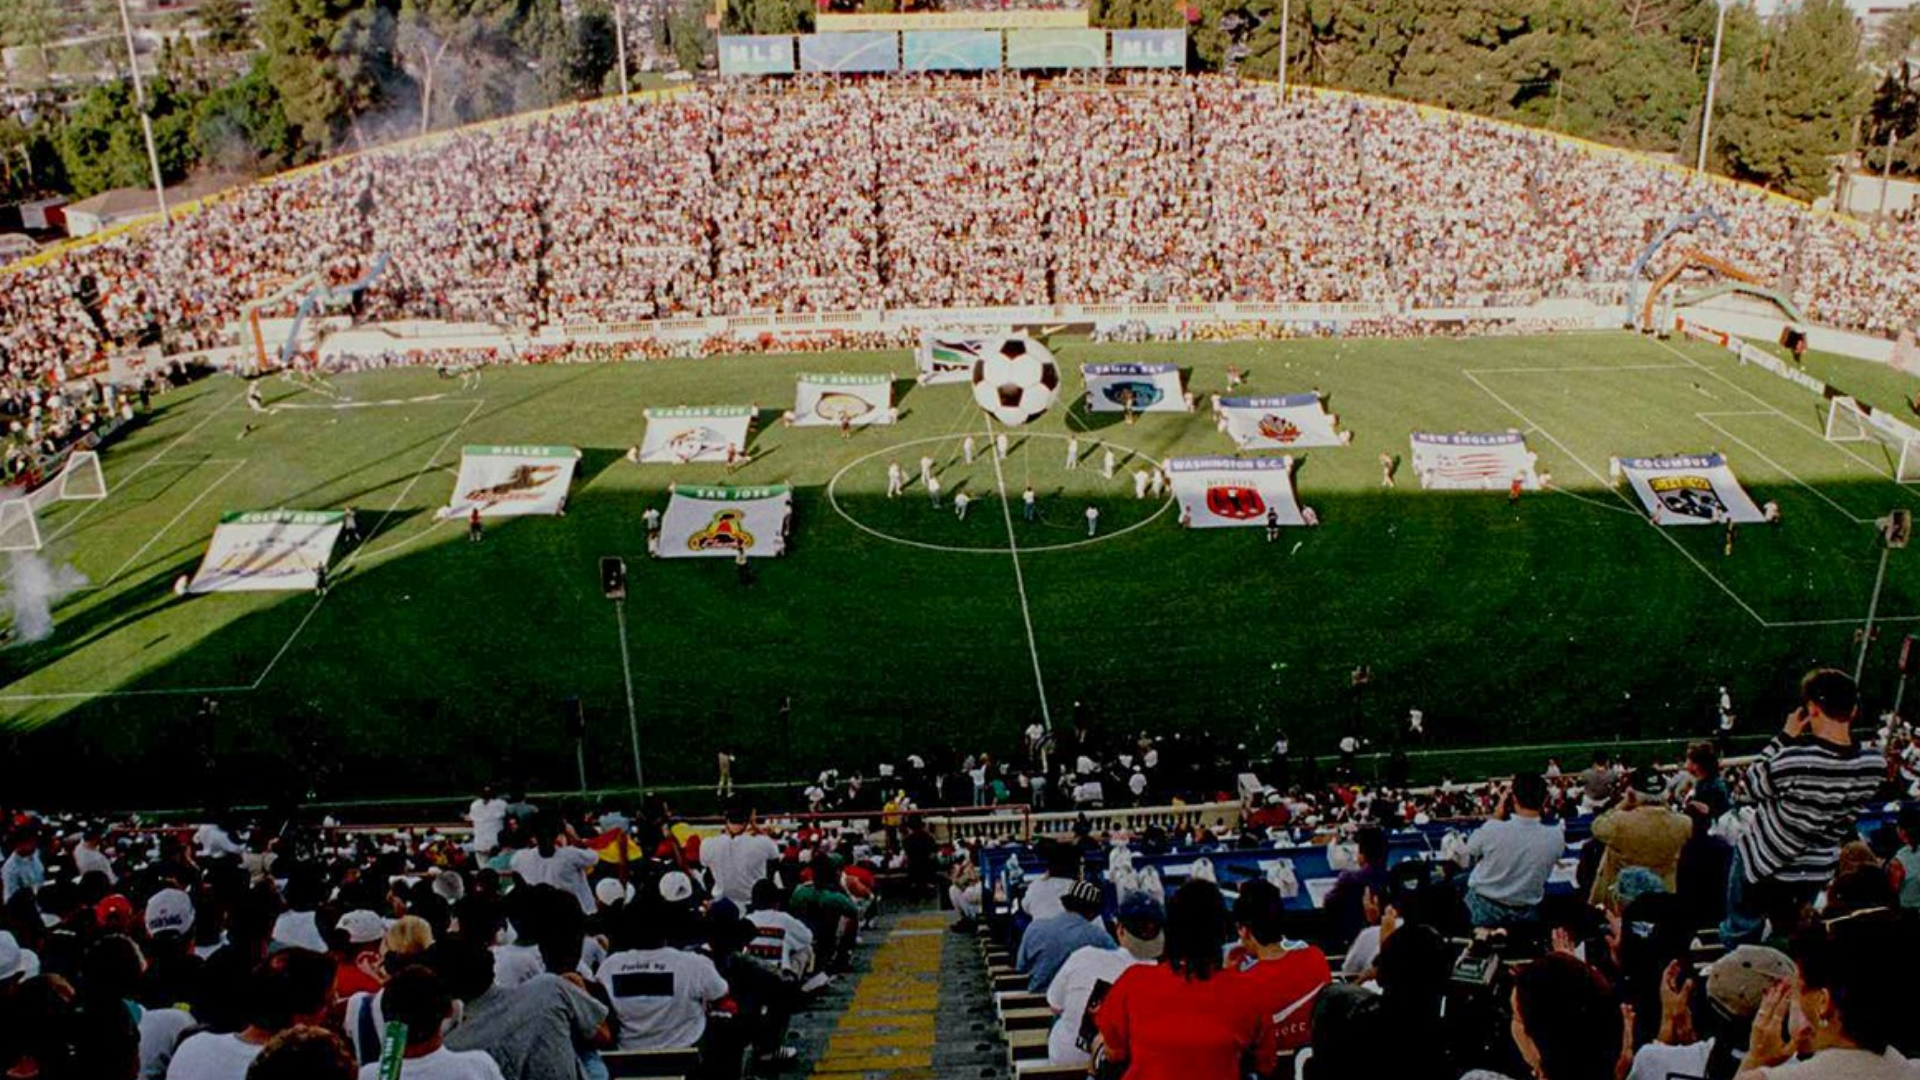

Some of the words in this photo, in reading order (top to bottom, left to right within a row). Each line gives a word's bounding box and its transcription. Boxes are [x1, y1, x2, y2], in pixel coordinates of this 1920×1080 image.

[730, 44, 784, 62] MLS
[1122, 39, 1176, 57] MLS
[1095, 364, 1137, 373] TAMPA
[1141, 364, 1164, 373] BAY
[656, 407, 710, 417] KANSAS
[714, 406, 745, 416] CITY
[1419, 433, 1448, 443] NEW
[1452, 434, 1517, 444] ENGLAND
[491, 445, 550, 456] DALLAS
[1172, 459, 1255, 470] WASHINGTON
[1634, 457, 1710, 468] COLUMBUS
[696, 488, 727, 499] SAN
